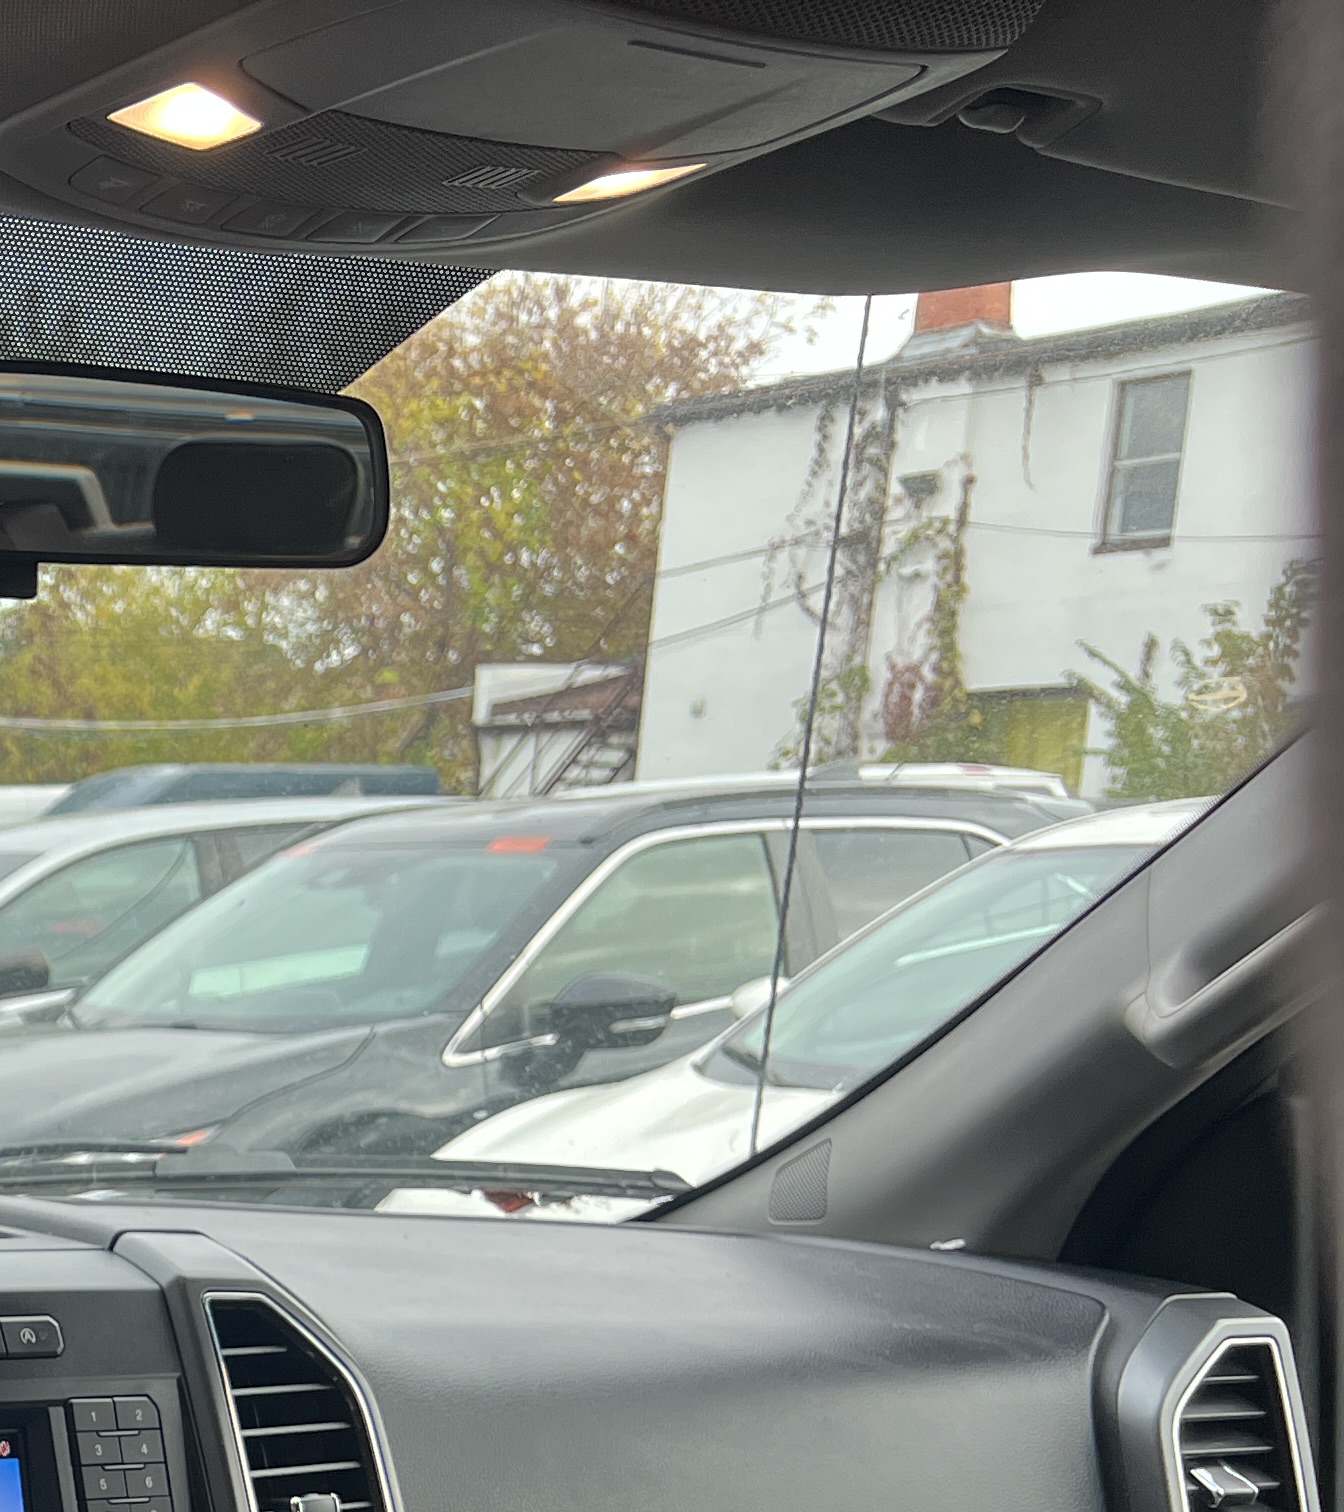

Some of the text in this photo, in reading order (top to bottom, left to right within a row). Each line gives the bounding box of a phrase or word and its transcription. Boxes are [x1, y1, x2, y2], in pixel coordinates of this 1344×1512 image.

[90, 1408, 143, 1422] 1 2
[94, 1443, 148, 1456] 3 4
[99, 1476, 153, 1491] 5 6
